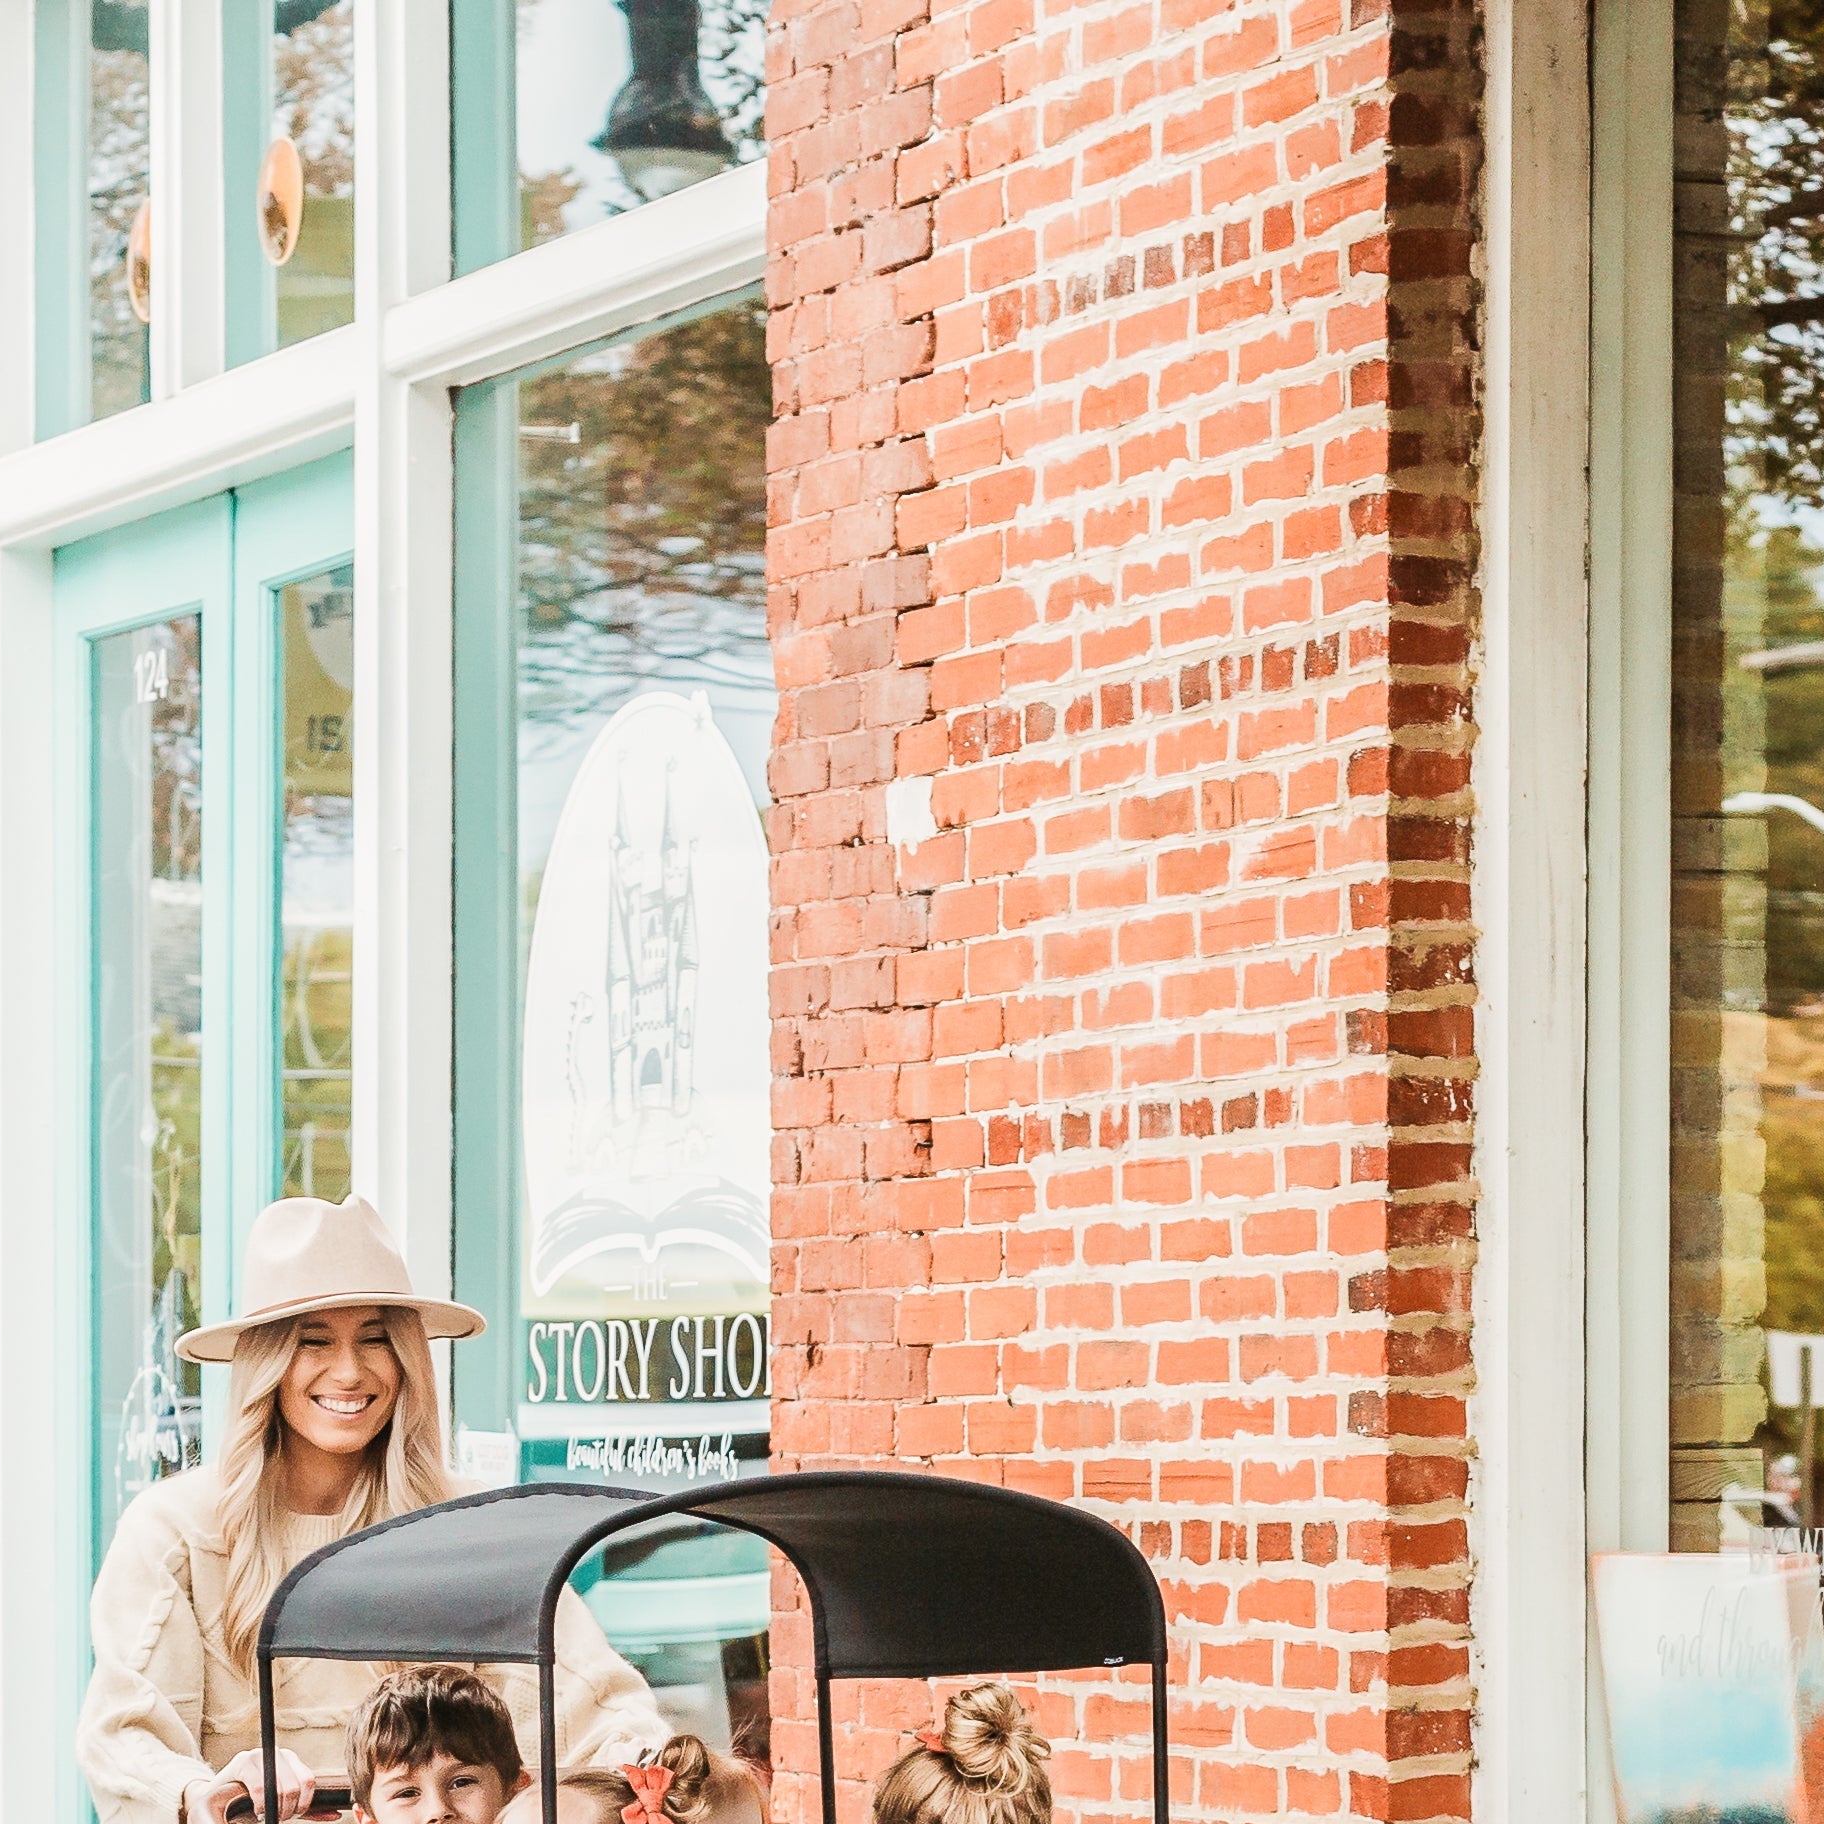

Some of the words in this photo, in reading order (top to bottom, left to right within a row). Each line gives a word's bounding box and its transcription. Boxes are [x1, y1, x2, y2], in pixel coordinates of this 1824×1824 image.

[133, 648, 169, 704] 124
[632, 1264, 667, 1301] THE
[527, 1318, 659, 1403] STORY
